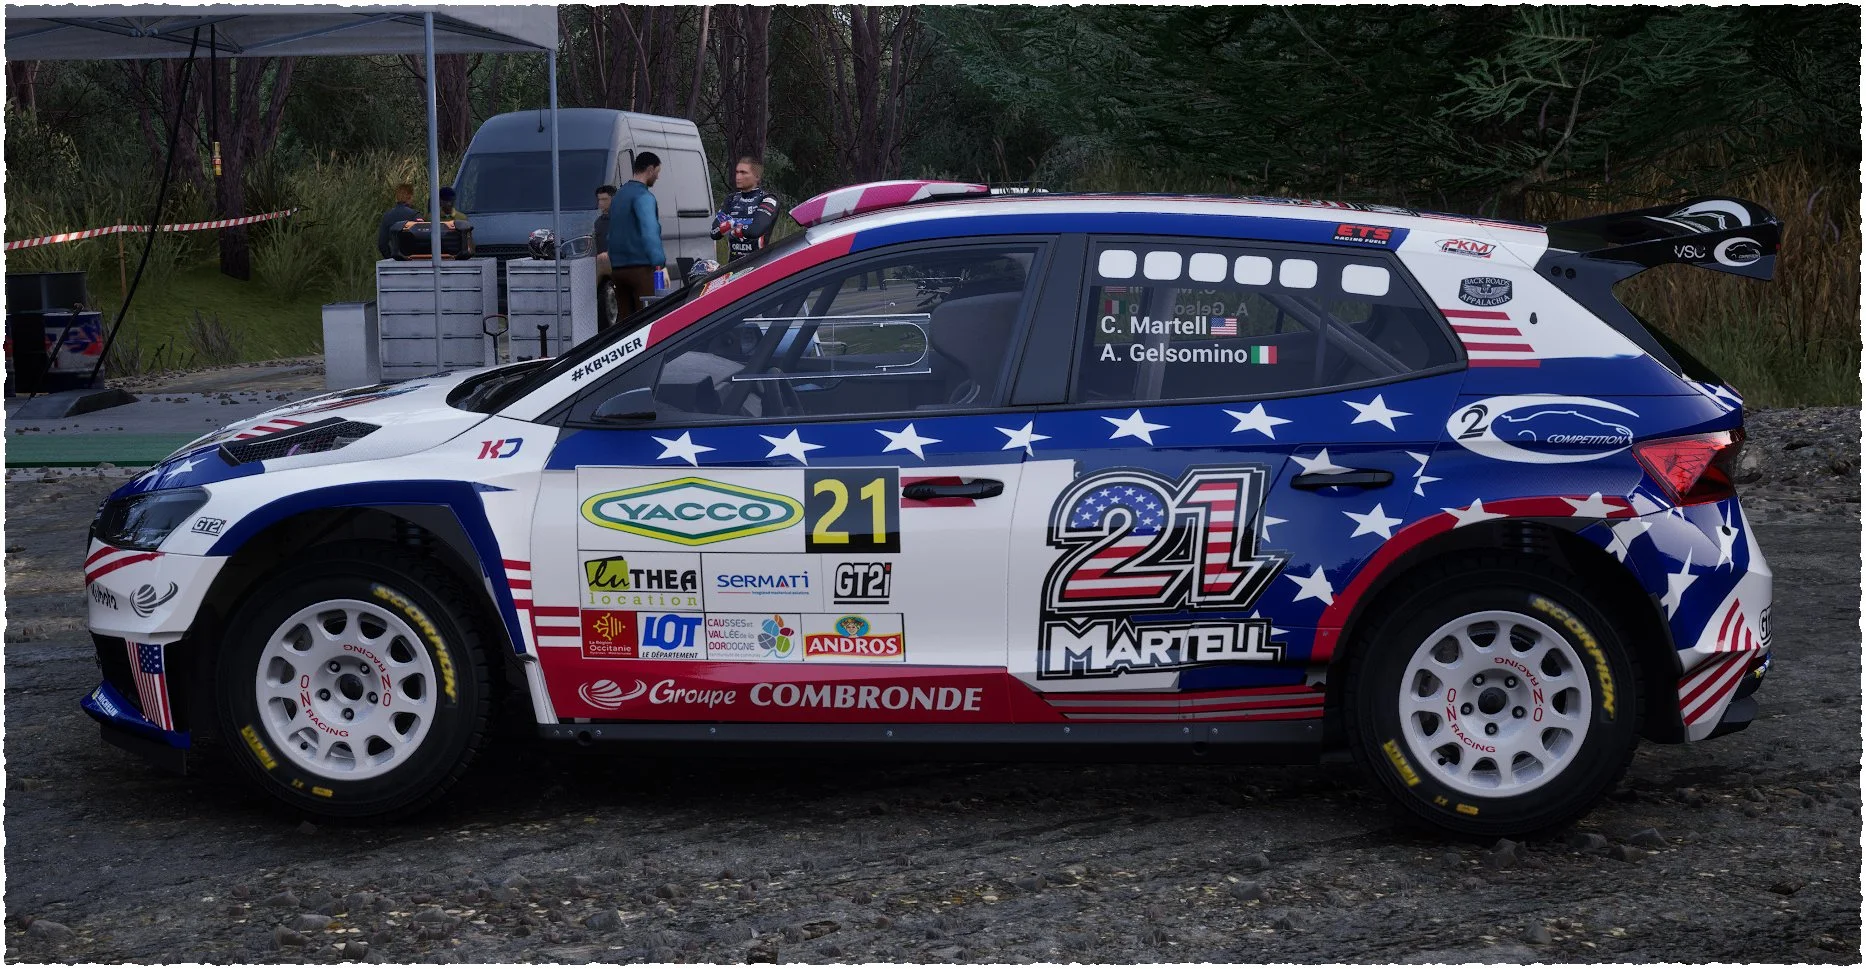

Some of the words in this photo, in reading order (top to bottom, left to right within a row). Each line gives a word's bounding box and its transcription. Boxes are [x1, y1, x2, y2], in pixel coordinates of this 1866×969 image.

[1337, 224, 1392, 240] ETS
[1446, 239, 1489, 253] PKM
[1464, 277, 1484, 285] BACK
[1485, 277, 1510, 286] ROADS
[1460, 294, 1510, 306] APPALACHIA
[1100, 316, 1122, 334] C.
[1130, 315, 1207, 335] Martell
[571, 337, 643, 382] #KB43VER
[1100, 343, 1122, 362] A.
[1130, 342, 1248, 363] Gelsomino
[1546, 434, 1627, 445] COMPETITION
[616, 502, 773, 522] YACCO
[812, 477, 887, 544] 21
[1046, 466, 1284, 612] 21
[588, 593, 698, 607] location
[641, 613, 703, 651] LOT
[707, 618, 746, 627] CAUSSES
[707, 629, 740, 639] VALLÉE
[589, 644, 632, 652] Occitanie
[642, 651, 650, 659] LE
[651, 650, 699, 659] DÉPARTEMENT
[707, 641, 755, 651] DORDOGNE
[808, 637, 898, 654] ANDROS
[1047, 622, 1276, 674] MARTELL
[343, 644, 386, 673] RACING
[1494, 657, 1539, 687] RACING
[97, 692, 119, 717] MICHELIN
[648, 679, 737, 707] Groupe
[749, 682, 983, 711] COMBRONDE
[305, 708, 349, 738] RACING
[1451, 723, 1496, 753] RACING
